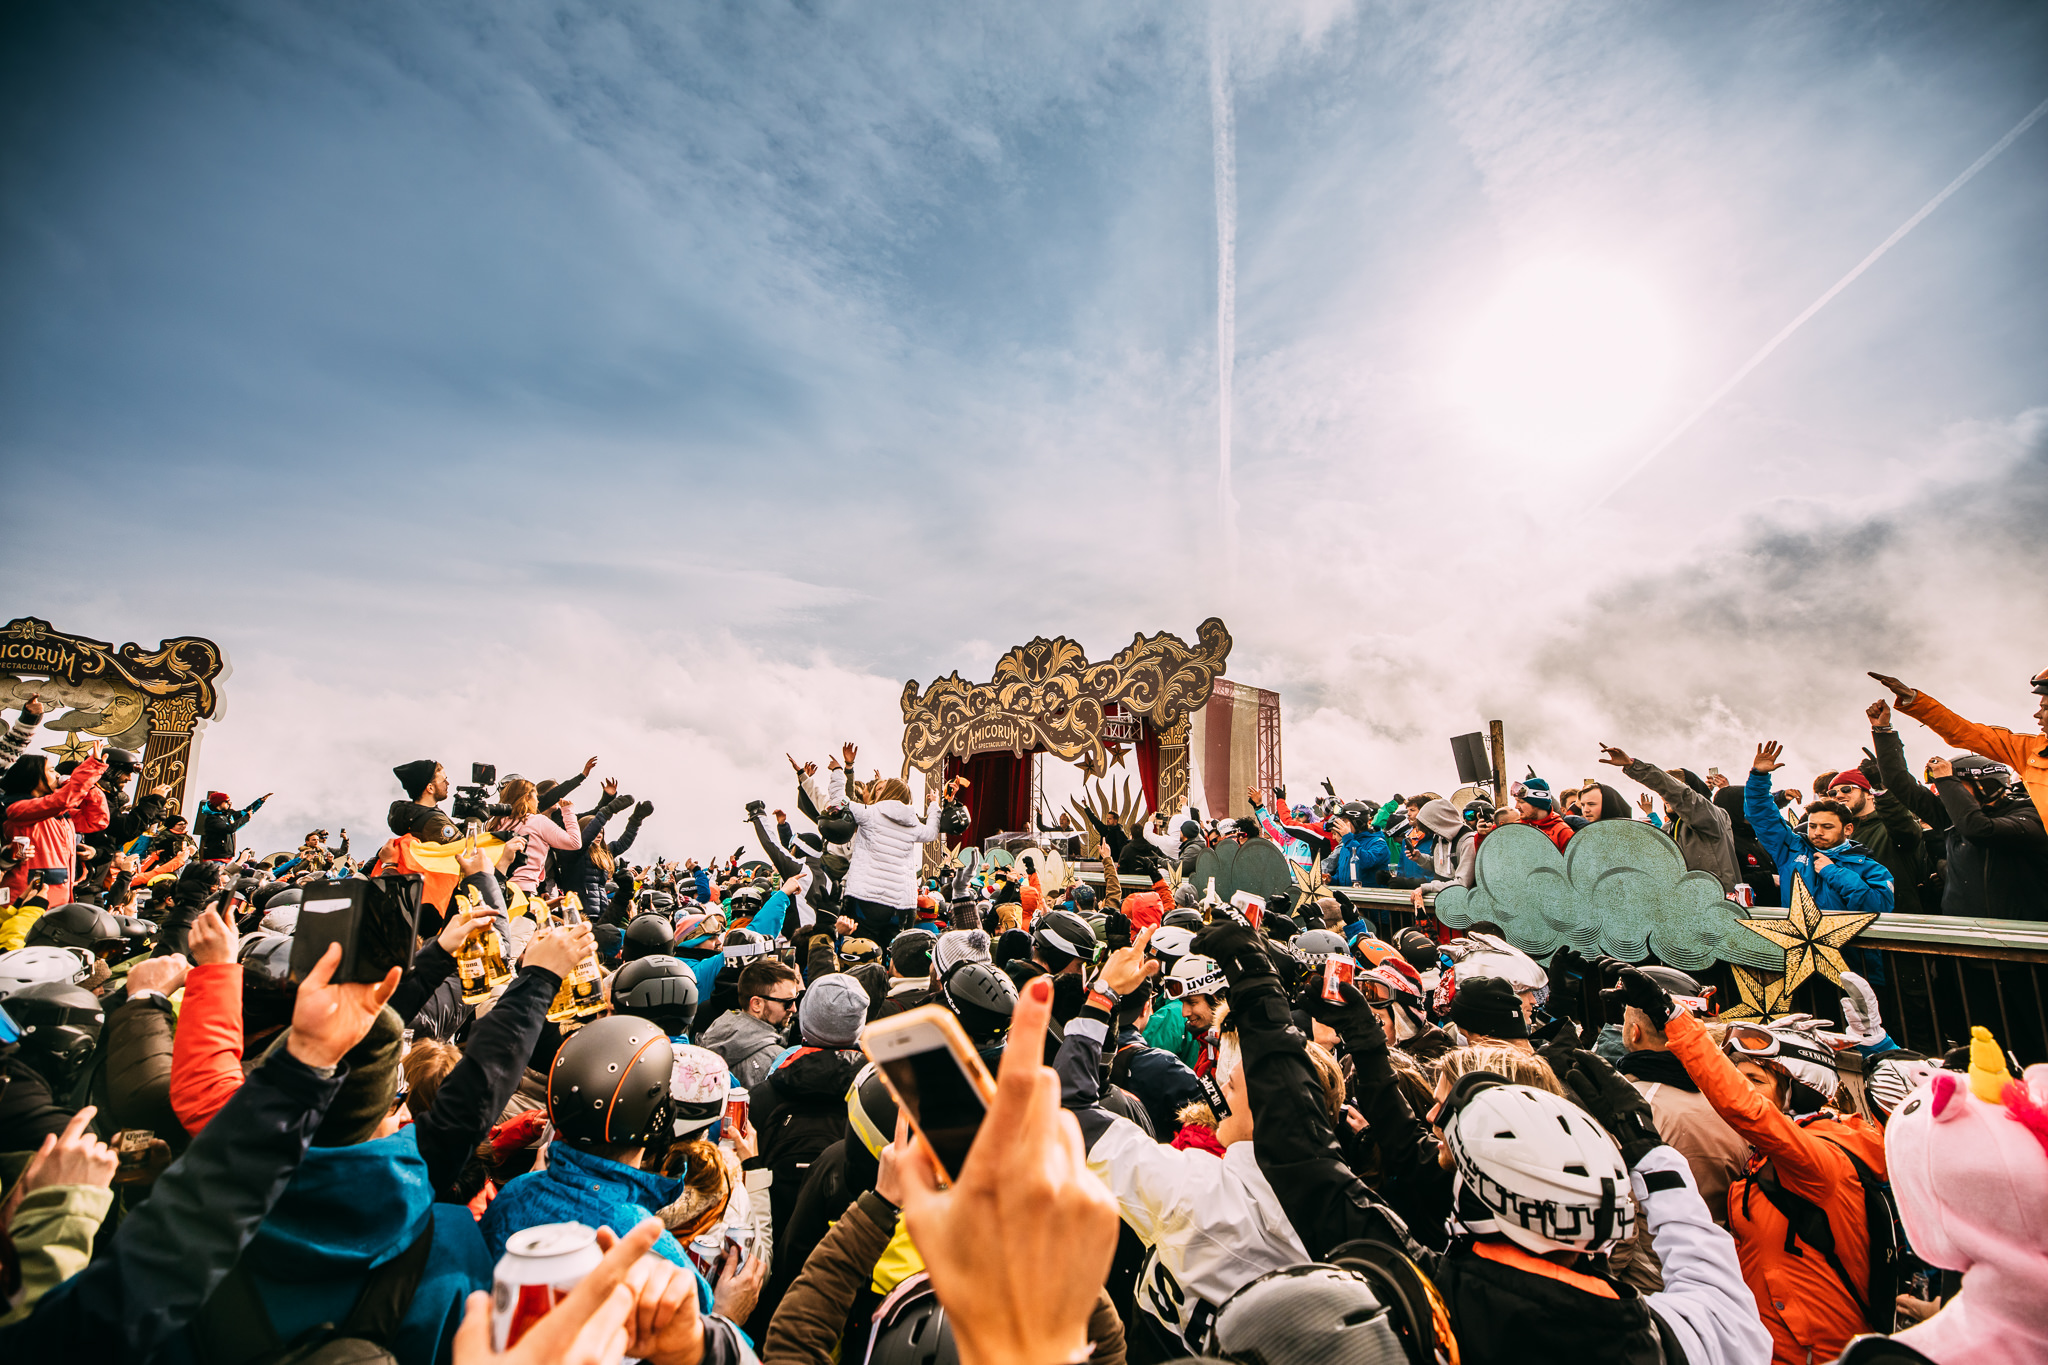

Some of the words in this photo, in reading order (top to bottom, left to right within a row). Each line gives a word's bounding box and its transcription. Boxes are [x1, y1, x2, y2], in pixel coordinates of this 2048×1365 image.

[0, 643, 76, 682] ICORUM
[0, 662, 50, 671] ECTACULUM
[964, 719, 1022, 760] AMICORUM
[978, 741, 1007, 749] SPECTACULUM
